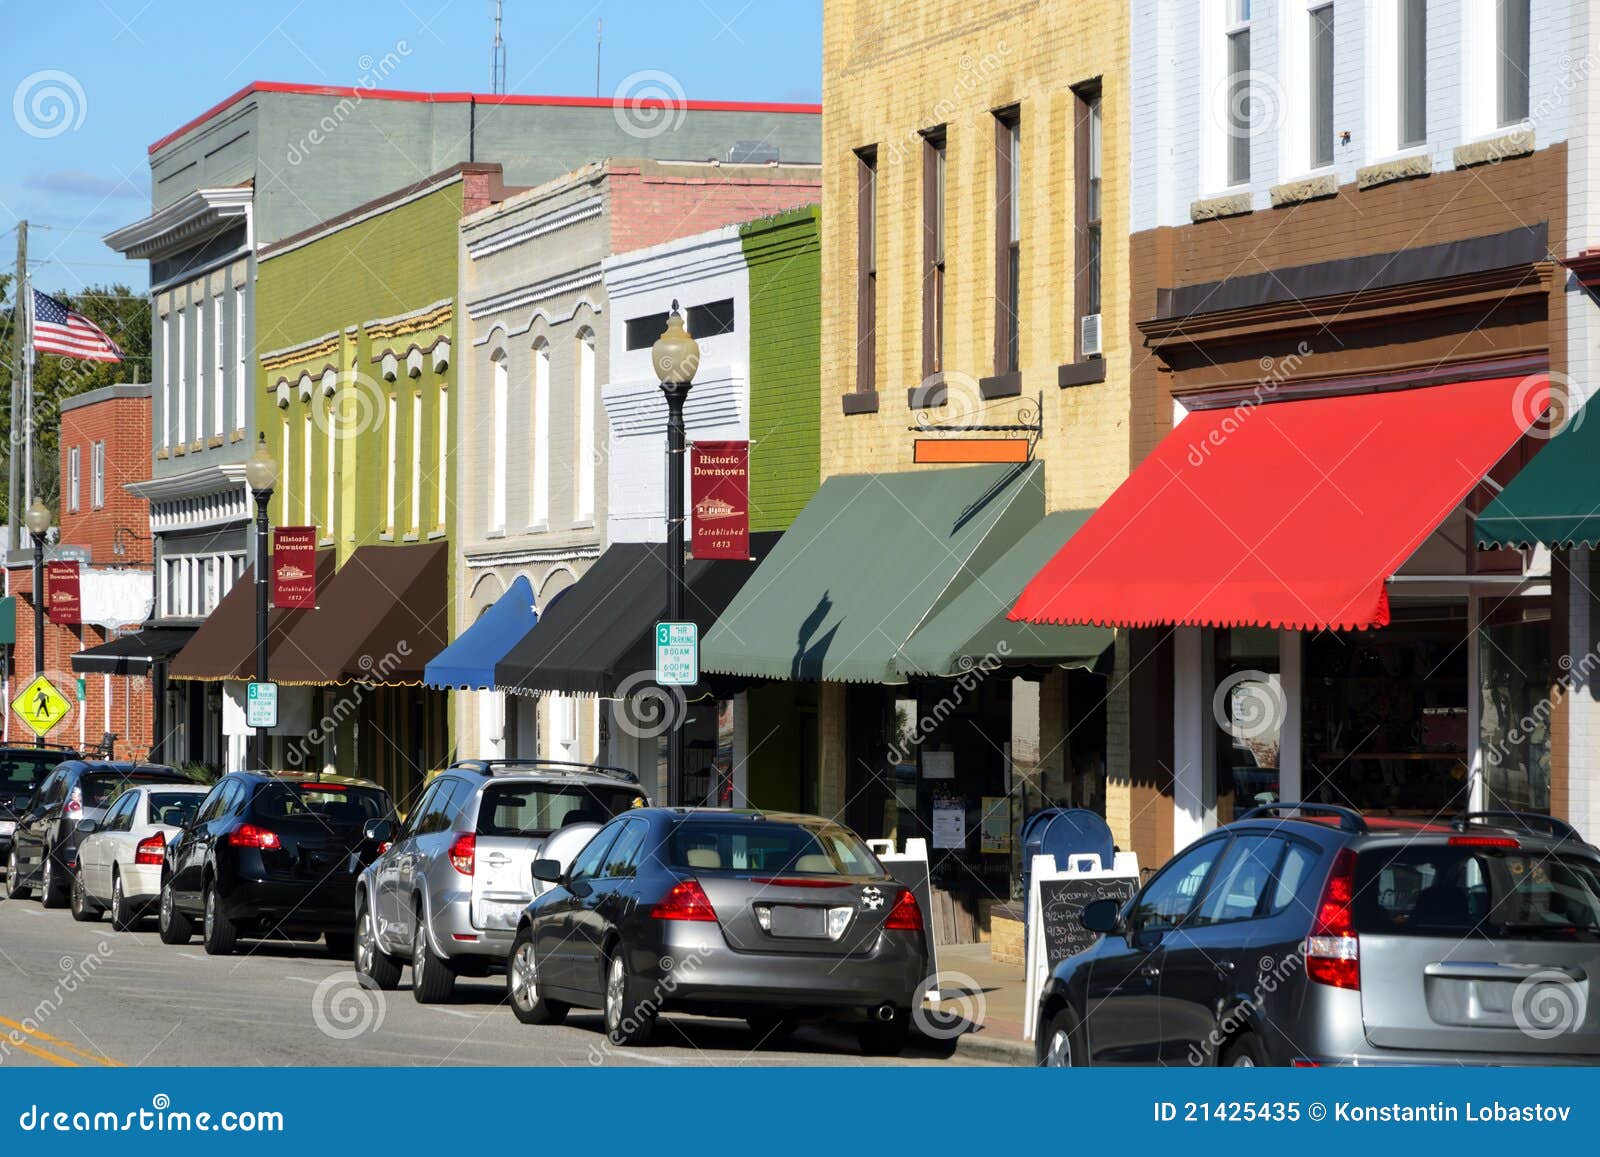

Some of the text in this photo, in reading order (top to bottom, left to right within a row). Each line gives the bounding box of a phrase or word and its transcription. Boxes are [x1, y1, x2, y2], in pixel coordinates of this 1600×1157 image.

[700, 455, 739, 464] Historic
[694, 467, 745, 476] Downtown
[698, 528, 744, 536] Established
[660, 627, 668, 643] 3
[250, 686, 257, 697] 3
